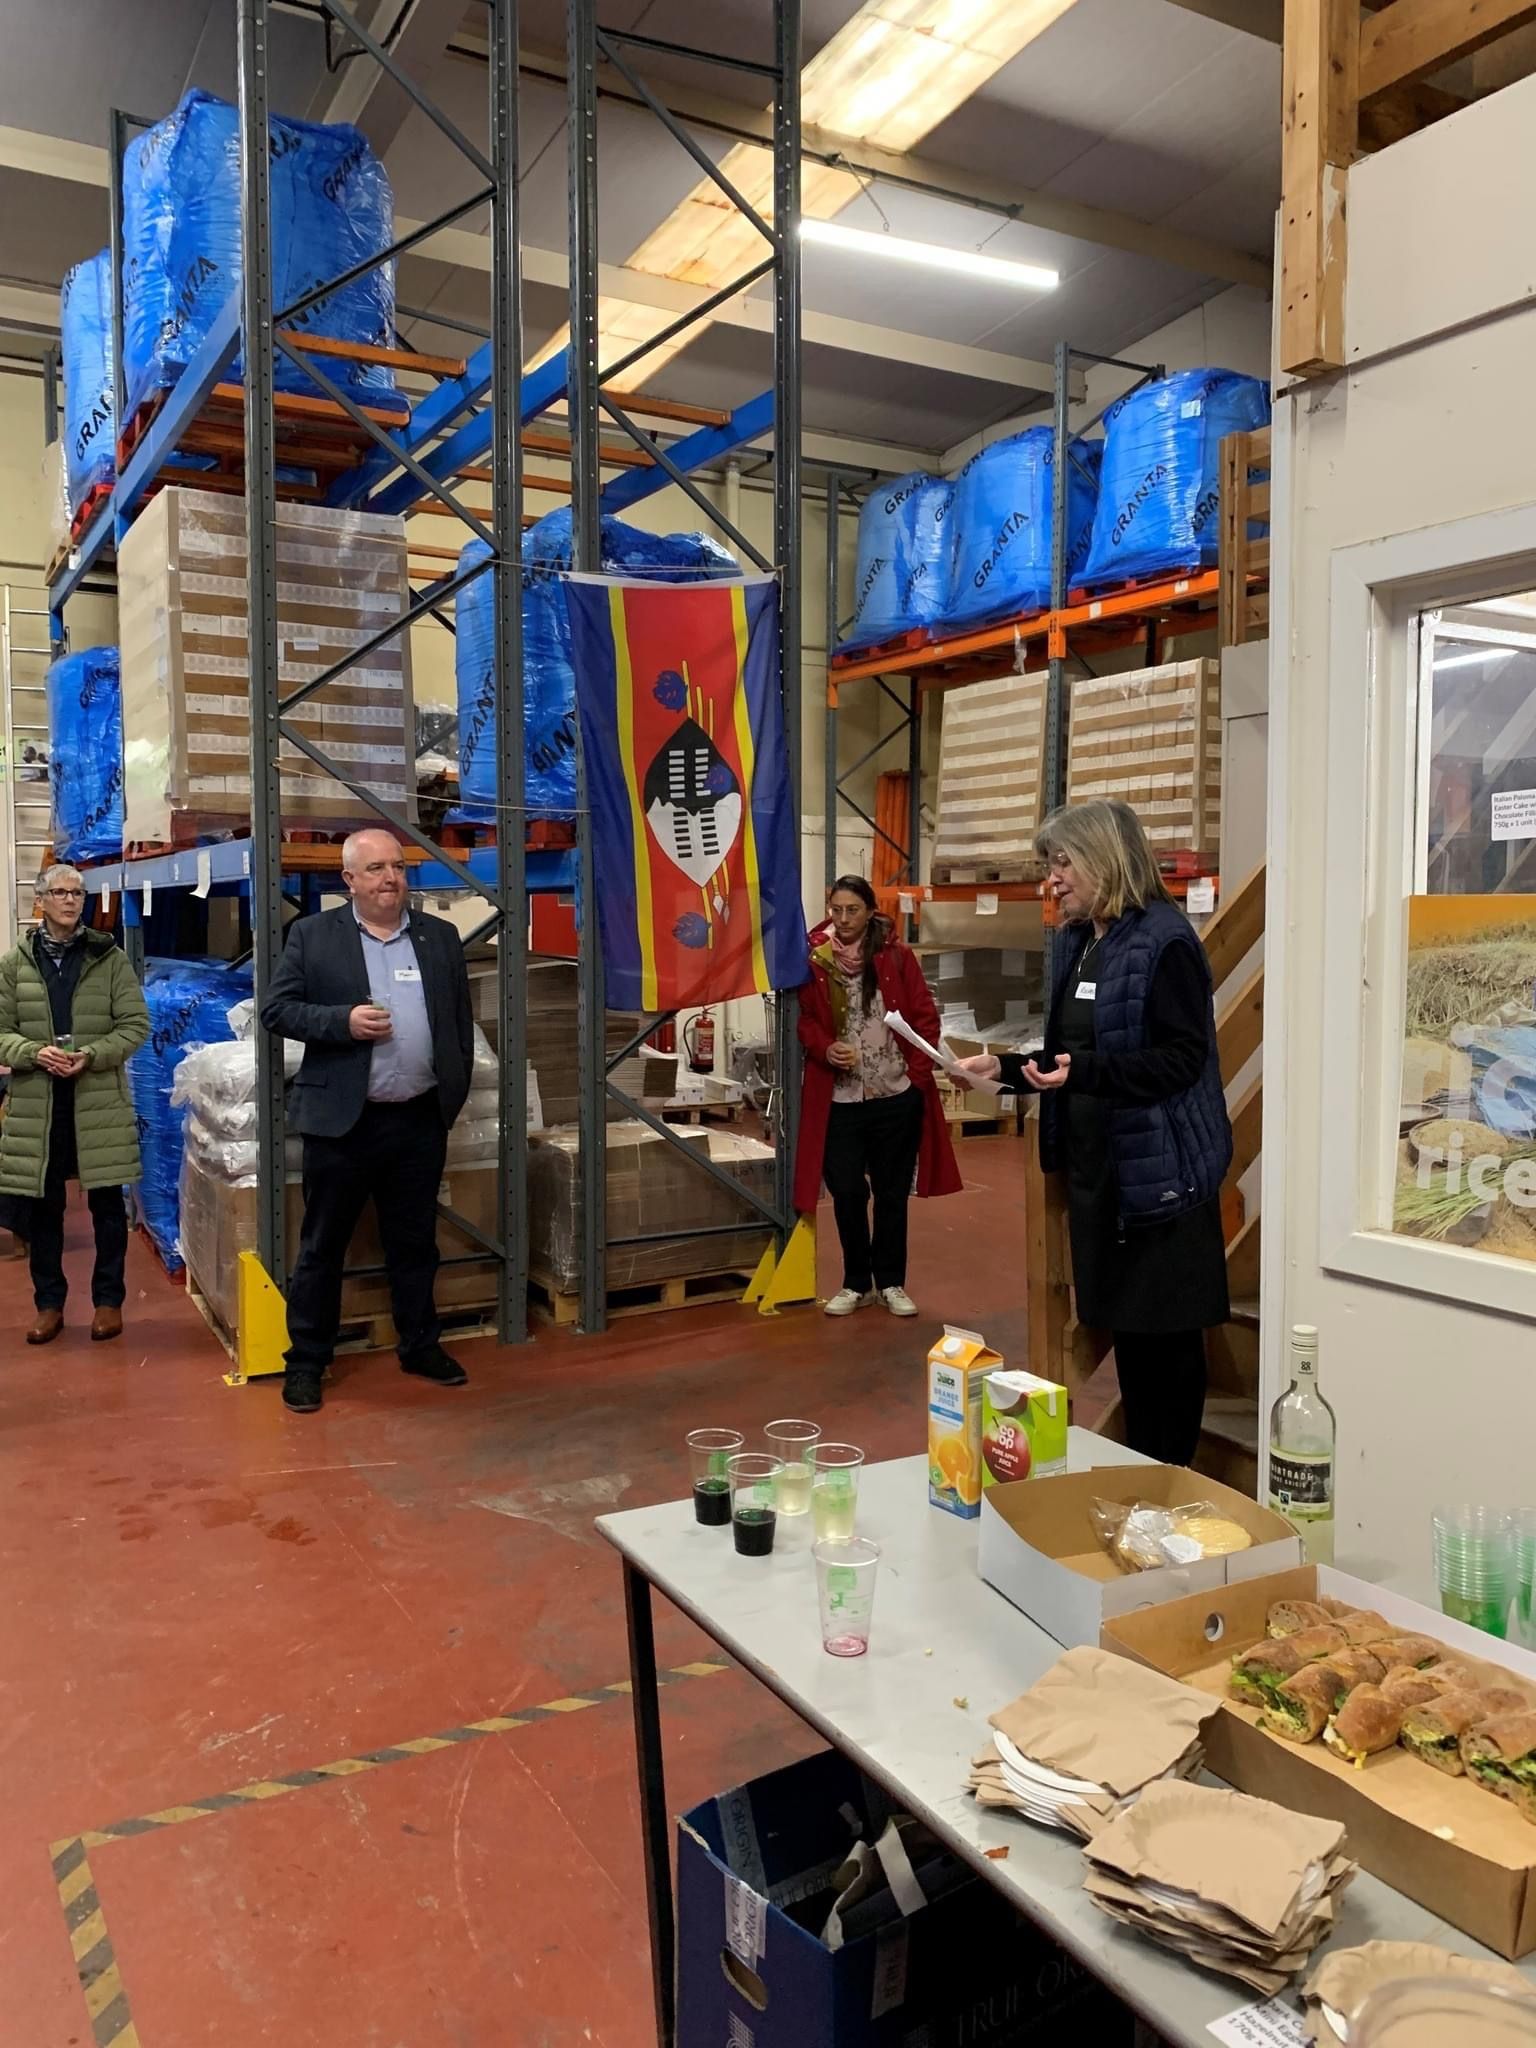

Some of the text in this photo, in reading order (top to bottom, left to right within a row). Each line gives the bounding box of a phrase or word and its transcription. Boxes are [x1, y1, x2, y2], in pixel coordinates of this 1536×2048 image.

[1112, 464, 1168, 546] GRANTA
[974, 511, 1029, 589] GRANTA
[1416, 1130, 1536, 1208] rice
